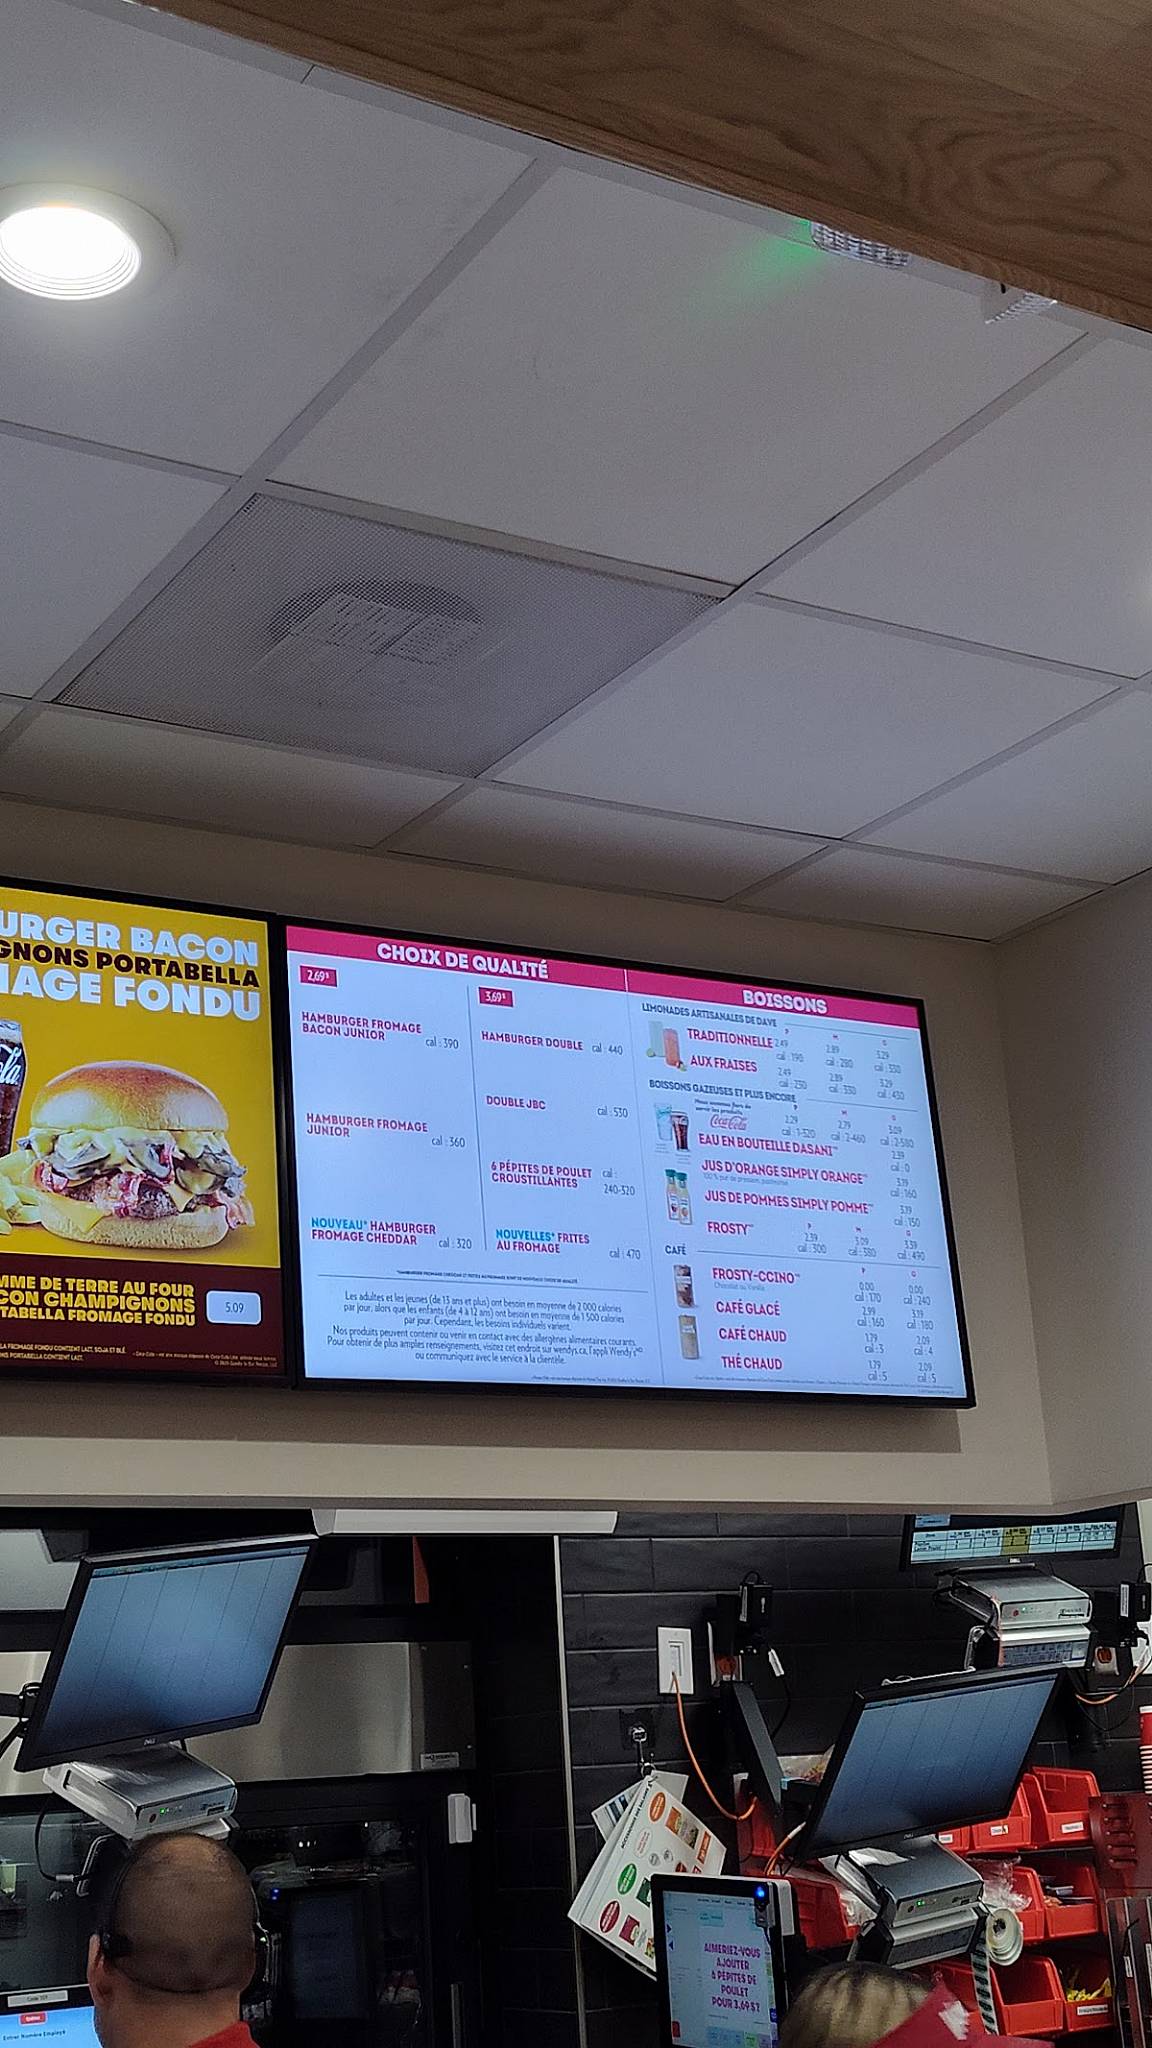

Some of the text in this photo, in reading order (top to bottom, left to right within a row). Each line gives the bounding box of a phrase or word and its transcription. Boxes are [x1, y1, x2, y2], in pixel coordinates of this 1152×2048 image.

[0, 910, 259, 966] URGER BACON
[376, 942, 549, 979] CHOIX DE QUALITÉ
[96, 951, 260, 988] PORTABELLA
[114, 976, 261, 1021] FONDU
[742, 989, 828, 1014] BOISSONS
[302, 1011, 422, 1034] HAMBURGER FROMAGE
[642, 1003, 777, 1027] LIMONADES ARTISANALES DE DAVE
[302, 1022, 385, 1040] BACON JUNIOR
[687, 1028, 773, 1048] TRADITIONNELLE
[481, 1031, 583, 1051] HAMBURGER DOUBLE
[608, 1044, 623, 1055] 440
[690, 1055, 757, 1072] AUX FRAISES
[649, 1079, 797, 1103] BOISSONS GAZEUSES ET PLUS ENCORE
[486, 1095, 546, 1110] DOUBLE JBC
[306, 1112, 428, 1132] HAMBURGER FROMAGE
[307, 1124, 350, 1138] JUNIOR
[699, 1133, 719, 1146] EAU
[722, 1136, 735, 1147] EN
[737, 1138, 791, 1153] BOUTEILLE
[491, 1160, 592, 1178] 6 PÉPITES DE POULET
[702, 1160, 722, 1172] JUS
[725, 1162, 779, 1177] D'ORANGE
[781, 1167, 819, 1181] SIMPLY
[491, 1173, 578, 1188] CROUSTILLANTES
[705, 1190, 727, 1203] JUS
[728, 1192, 742, 1204] DE
[743, 1193, 789, 1208] POMMES
[791, 1197, 829, 1211] SIMPLY
[370, 1220, 436, 1235] HAMBURGER
[312, 1229, 417, 1245] FROMAGE CHEDDAR
[457, 1238, 472, 1249] 320
[557, 1232, 590, 1244] FRITES
[497, 1240, 560, 1254] AU FROMAGE
[627, 1249, 641, 1260] 470
[665, 1243, 686, 1255] CAFÉ
[40, 1276, 62, 1290] DE
[65, 1278, 118, 1294] TERRE
[123, 1281, 145, 1295] AU
[150, 1283, 194, 1298] FOUR
[44, 1291, 196, 1313] CHAMPIGNONS
[345, 1290, 428, 1306] Les adultes et les jeunes
[491, 1298, 566, 1313] ont besoin en moyenne
[0, 1306, 196, 1326] TABELLA FROMAGE FONDU
[225, 1303, 244, 1314] 5.09
[716, 1299, 780, 1316] CAFÉ GLACÉ
[333, 1325, 347, 1336] Nos
[350, 1328, 378, 1338] produits
[380, 1329, 408, 1338] peuvent
[409, 1329, 438, 1339] contenir
[450, 1331, 467, 1340] venir
[568, 1335, 607, 1345] alimentaires
[719, 1325, 787, 1342] CAFÉ CHAUD
[721, 1353, 783, 1370] THÉ CHAUD
[704, 1943, 761, 1959] AIMERIEZ-VOUS
[716, 1958, 750, 1971] AJOUTER
[711, 1971, 716, 1980] 6
[748, 1974, 757, 1985] DE
[721, 1984, 749, 1997] POULET
[712, 1996, 732, 2008] POUR
